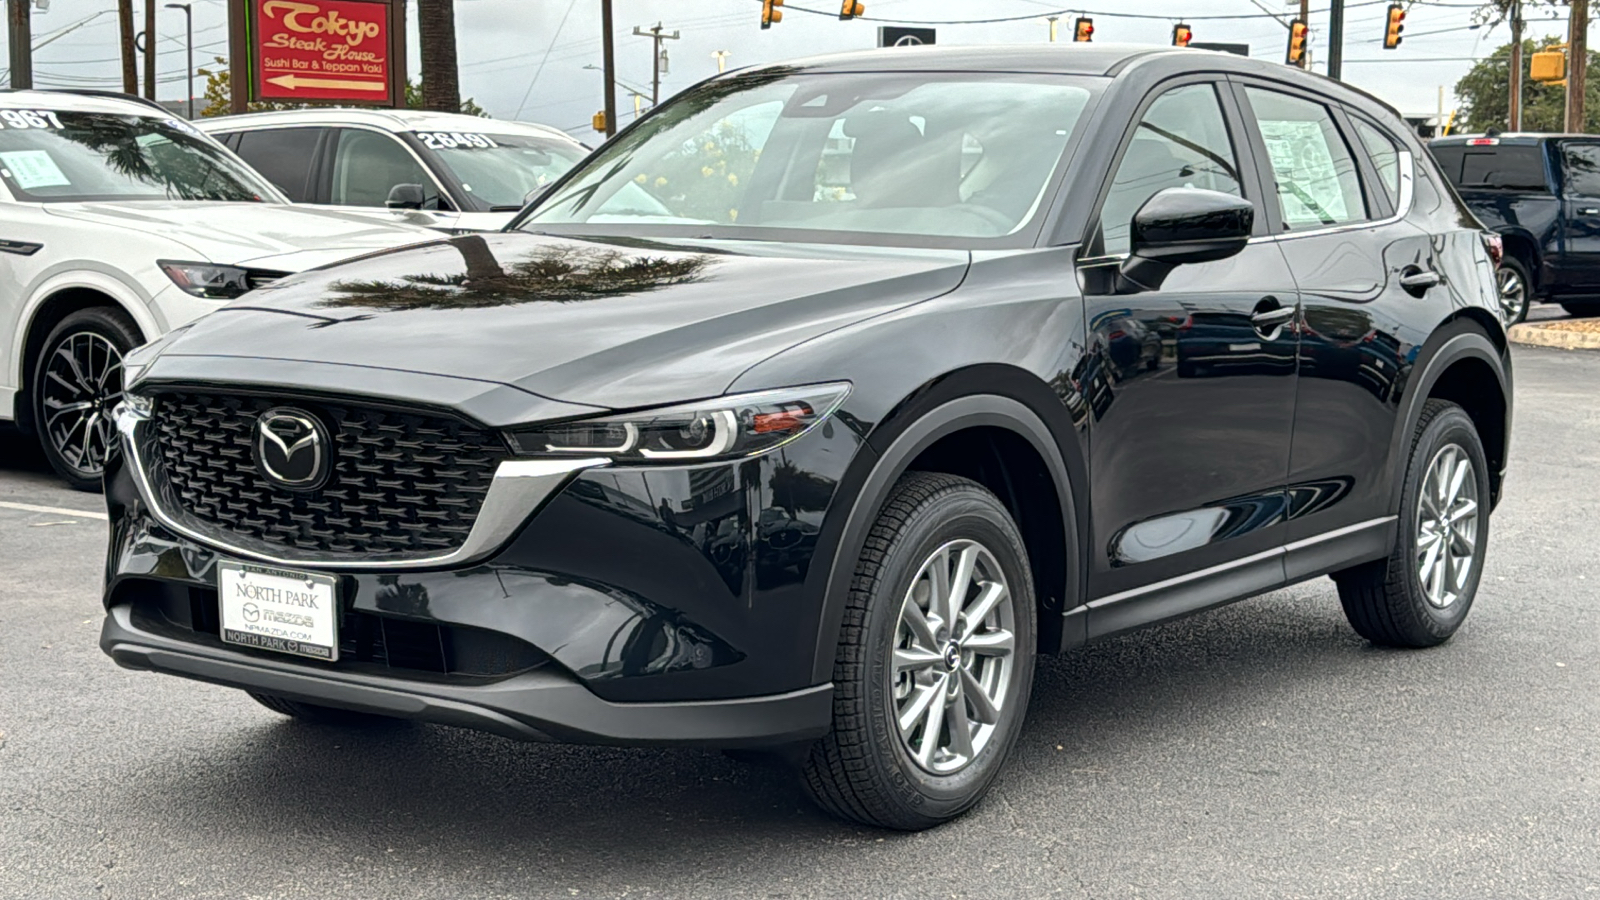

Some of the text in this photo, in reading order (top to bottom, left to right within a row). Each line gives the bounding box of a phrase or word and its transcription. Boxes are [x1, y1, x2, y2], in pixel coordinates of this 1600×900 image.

[263, 0, 379, 46] Tokyo
[263, 33, 384, 63] Steak House
[264, 57, 382, 73] Sushi Bar & Teppan Yaki
[0, 110, 64, 129] 967
[417, 132, 498, 150] 26491
[265, 568, 307, 580] ANTONIO
[236, 582, 319, 609] NORTH PARK
[245, 623, 312, 640] NPMAZDA.COM
[227, 631, 329, 657] NORTH PARK mazda
